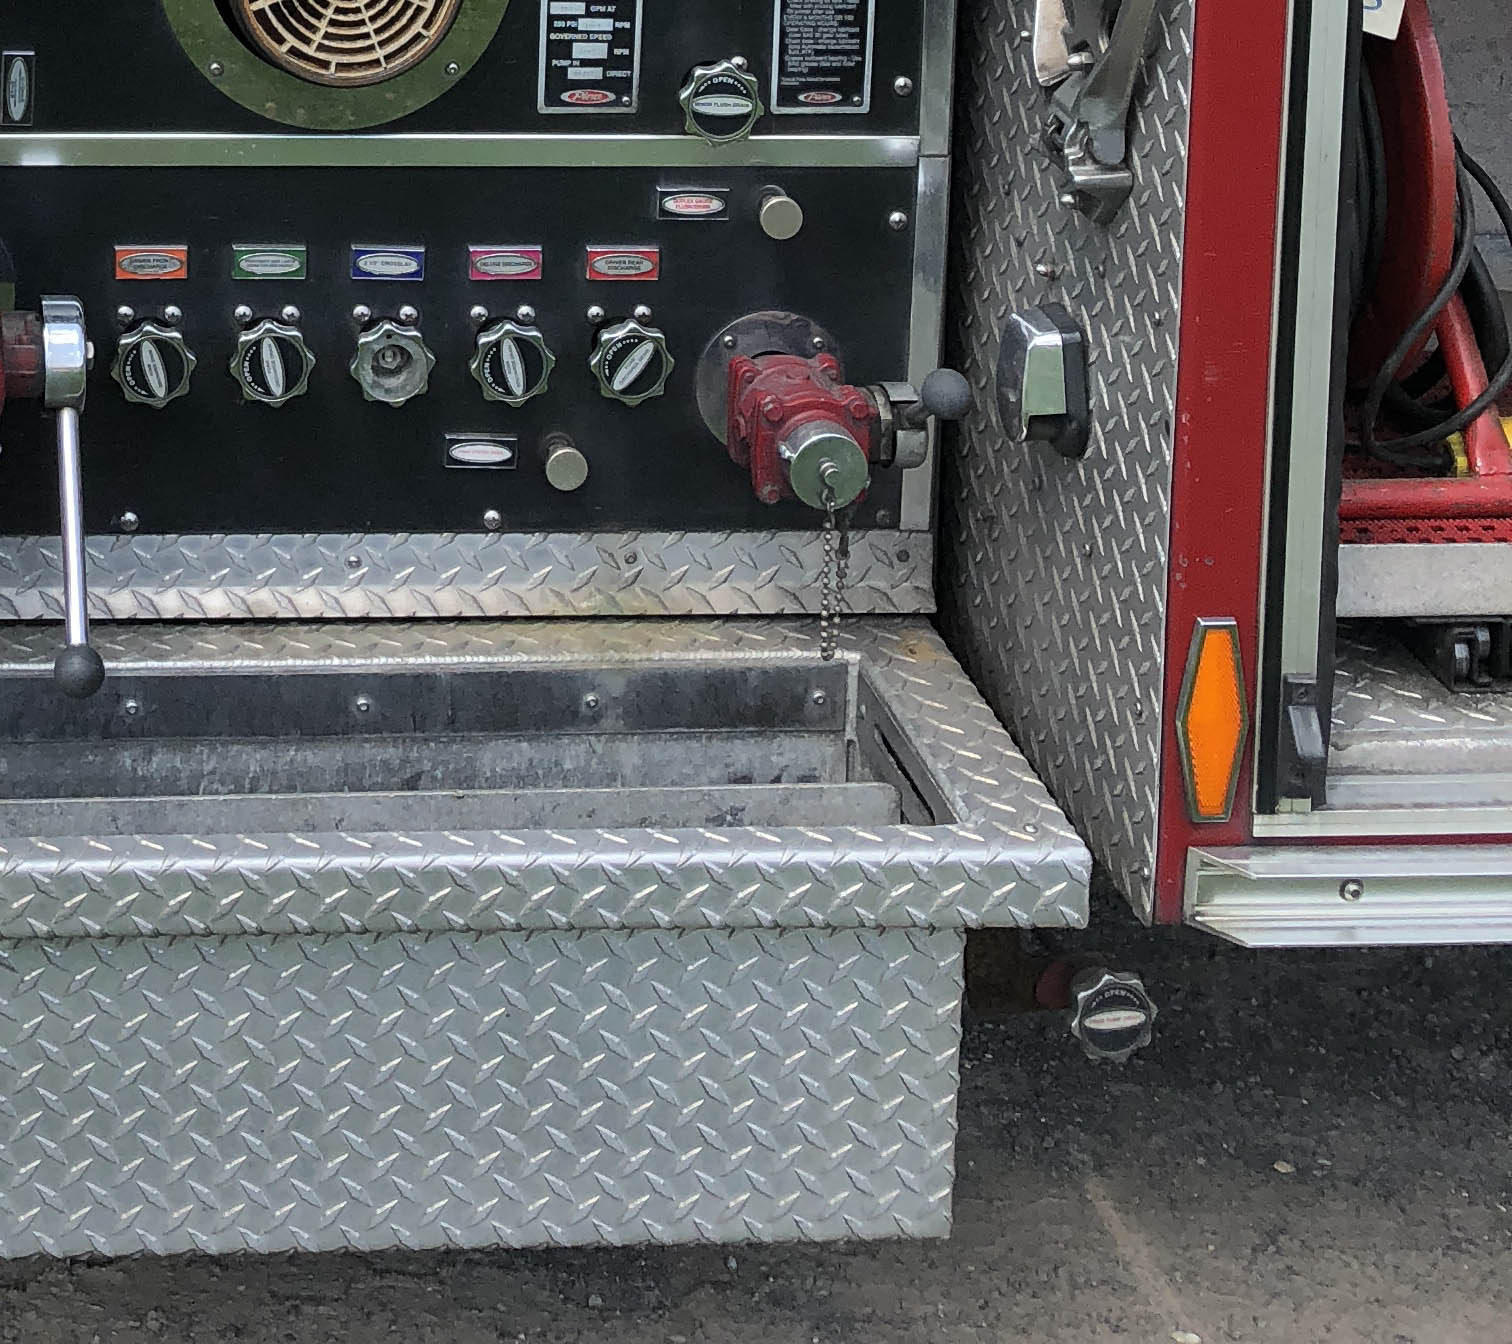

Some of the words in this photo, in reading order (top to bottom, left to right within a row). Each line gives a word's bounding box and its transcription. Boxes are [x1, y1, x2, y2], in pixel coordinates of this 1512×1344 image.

[607, 341, 623, 361] OPEN
[125, 365, 135, 386] OPEN
[245, 361, 254, 383] OPEN
[483, 363, 493, 384] OPEN
